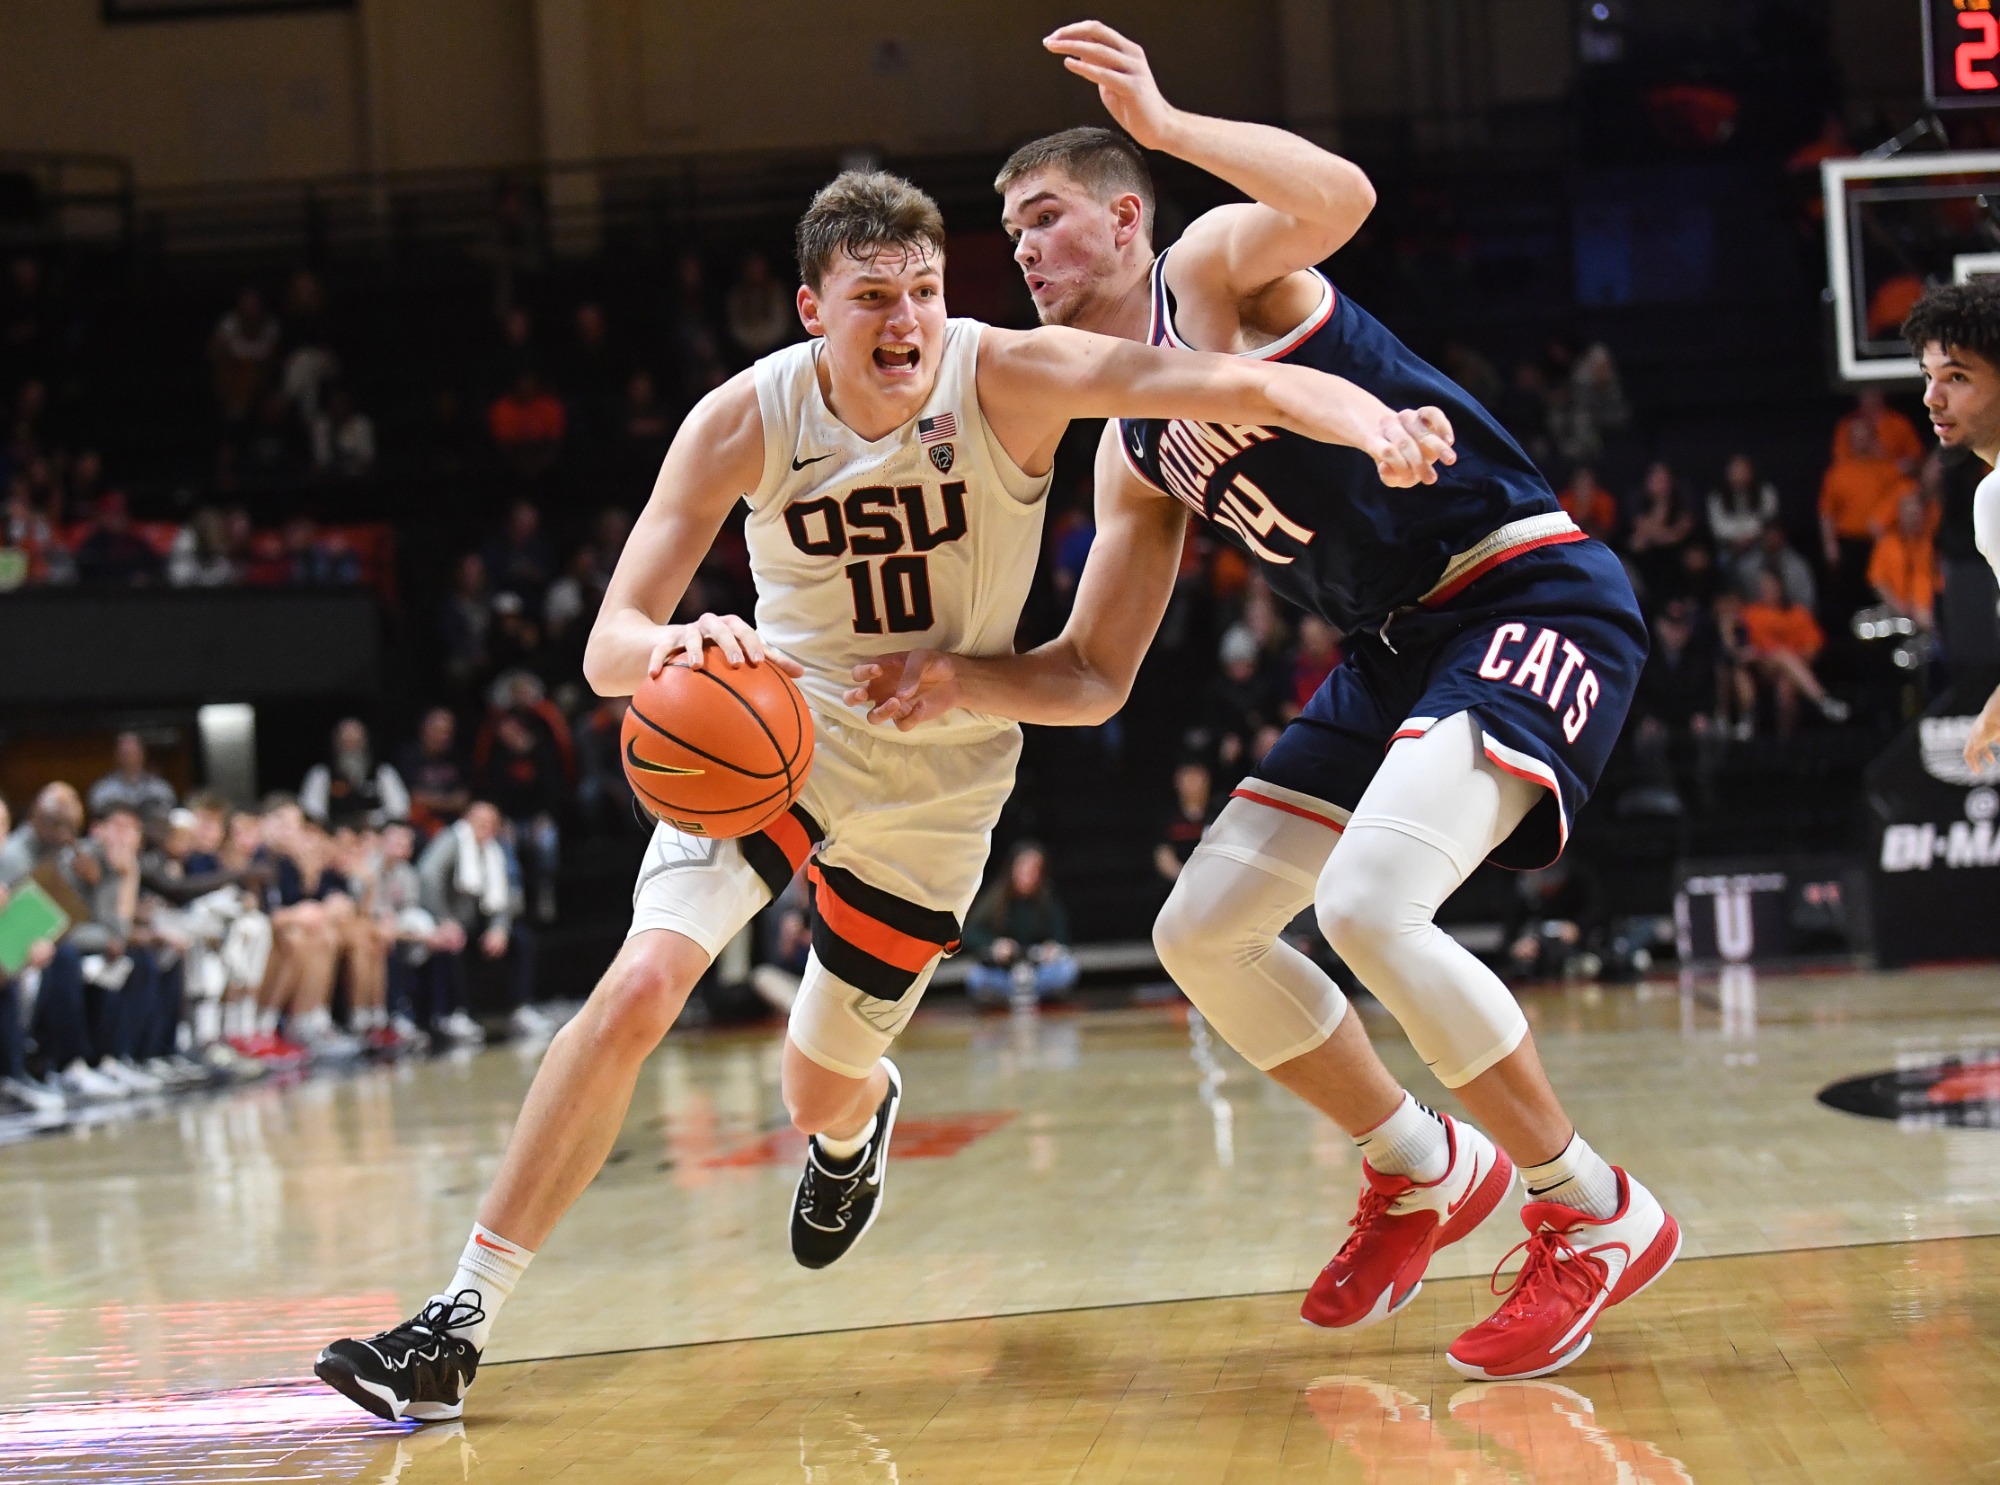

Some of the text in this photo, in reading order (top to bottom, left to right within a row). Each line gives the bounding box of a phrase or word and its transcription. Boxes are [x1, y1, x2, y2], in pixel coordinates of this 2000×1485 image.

[783, 480, 968, 557] OSU
[845, 555, 935, 634] 10
[1477, 622, 1600, 744] CATS
